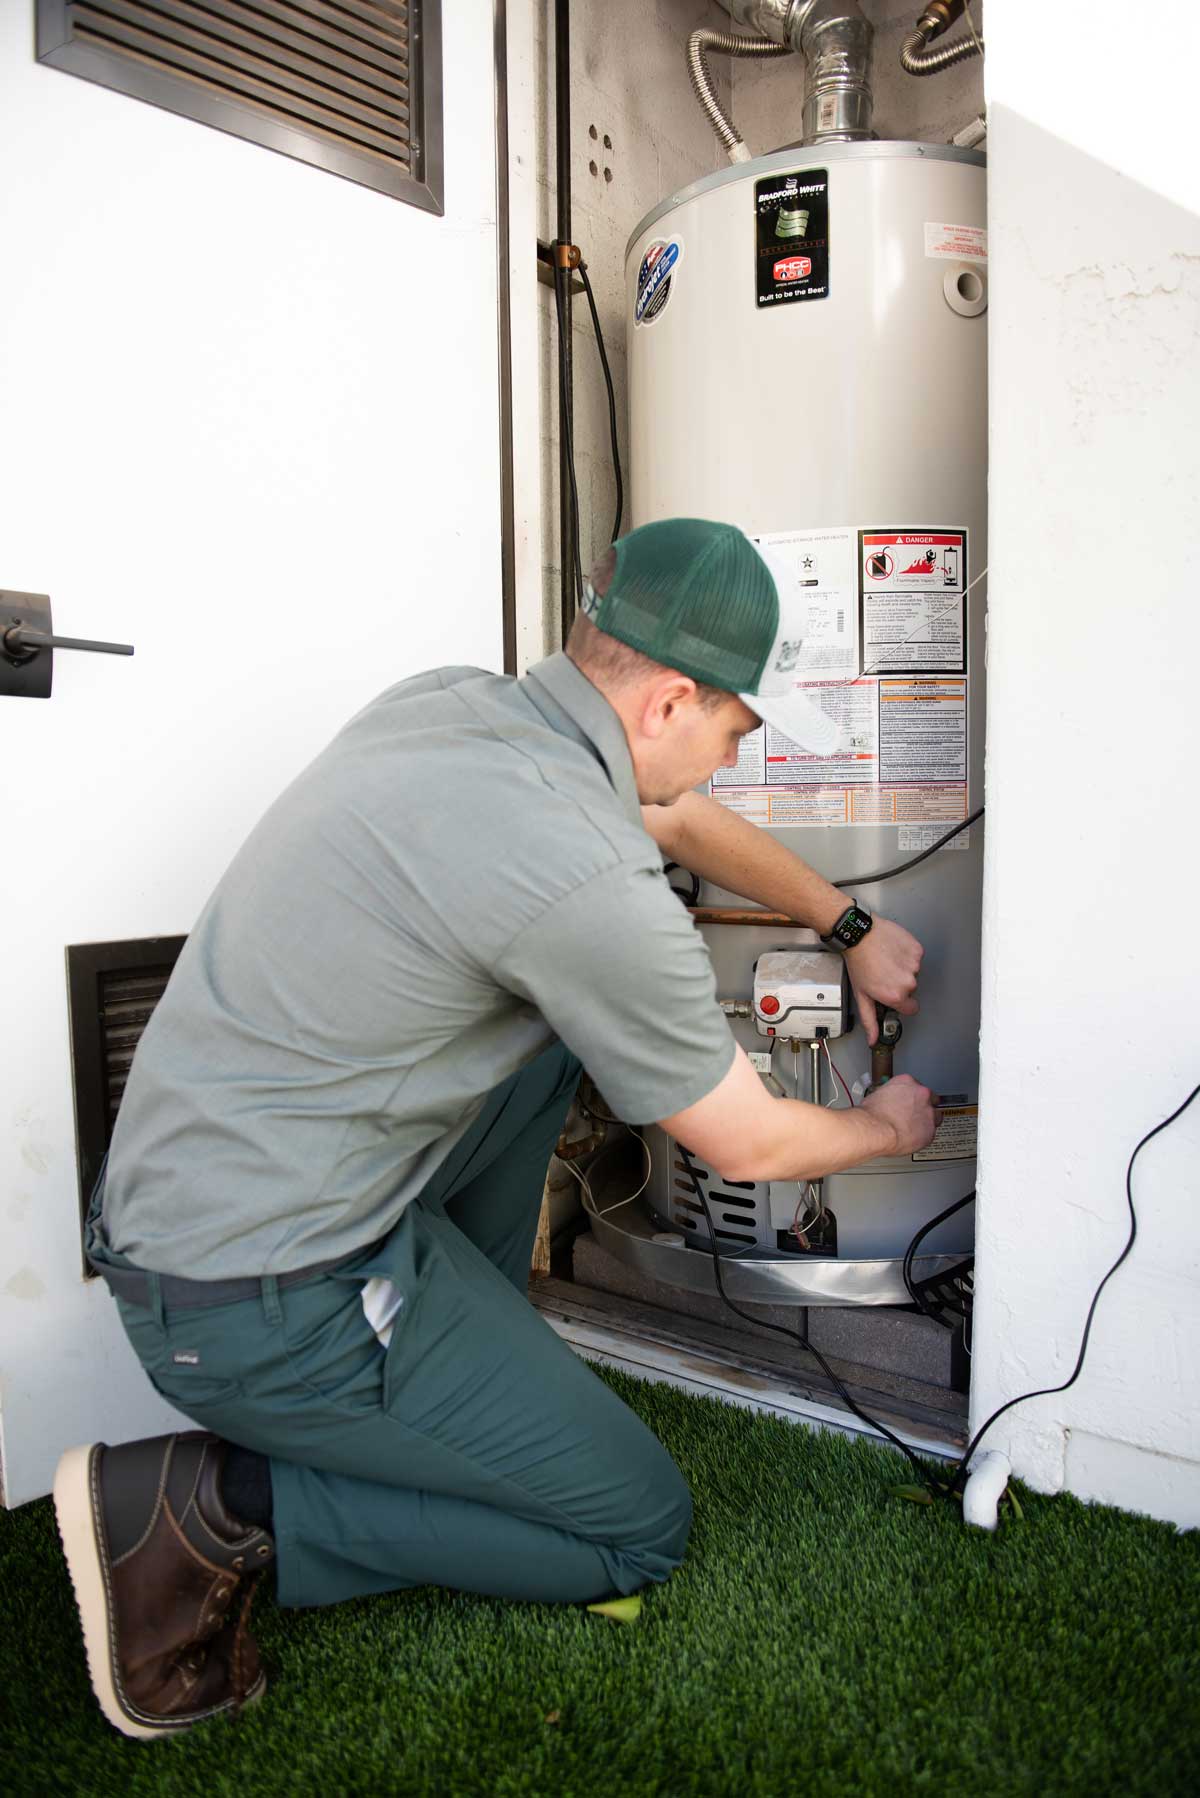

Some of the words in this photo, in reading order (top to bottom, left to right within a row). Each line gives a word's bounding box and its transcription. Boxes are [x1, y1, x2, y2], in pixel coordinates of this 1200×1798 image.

[758, 188, 798, 203] BRADFORD
[800, 184, 824, 194] WHITE
[775, 260, 809, 272] PHCC
[759, 294, 774, 302] Built
[808, 286, 825, 294] Best
